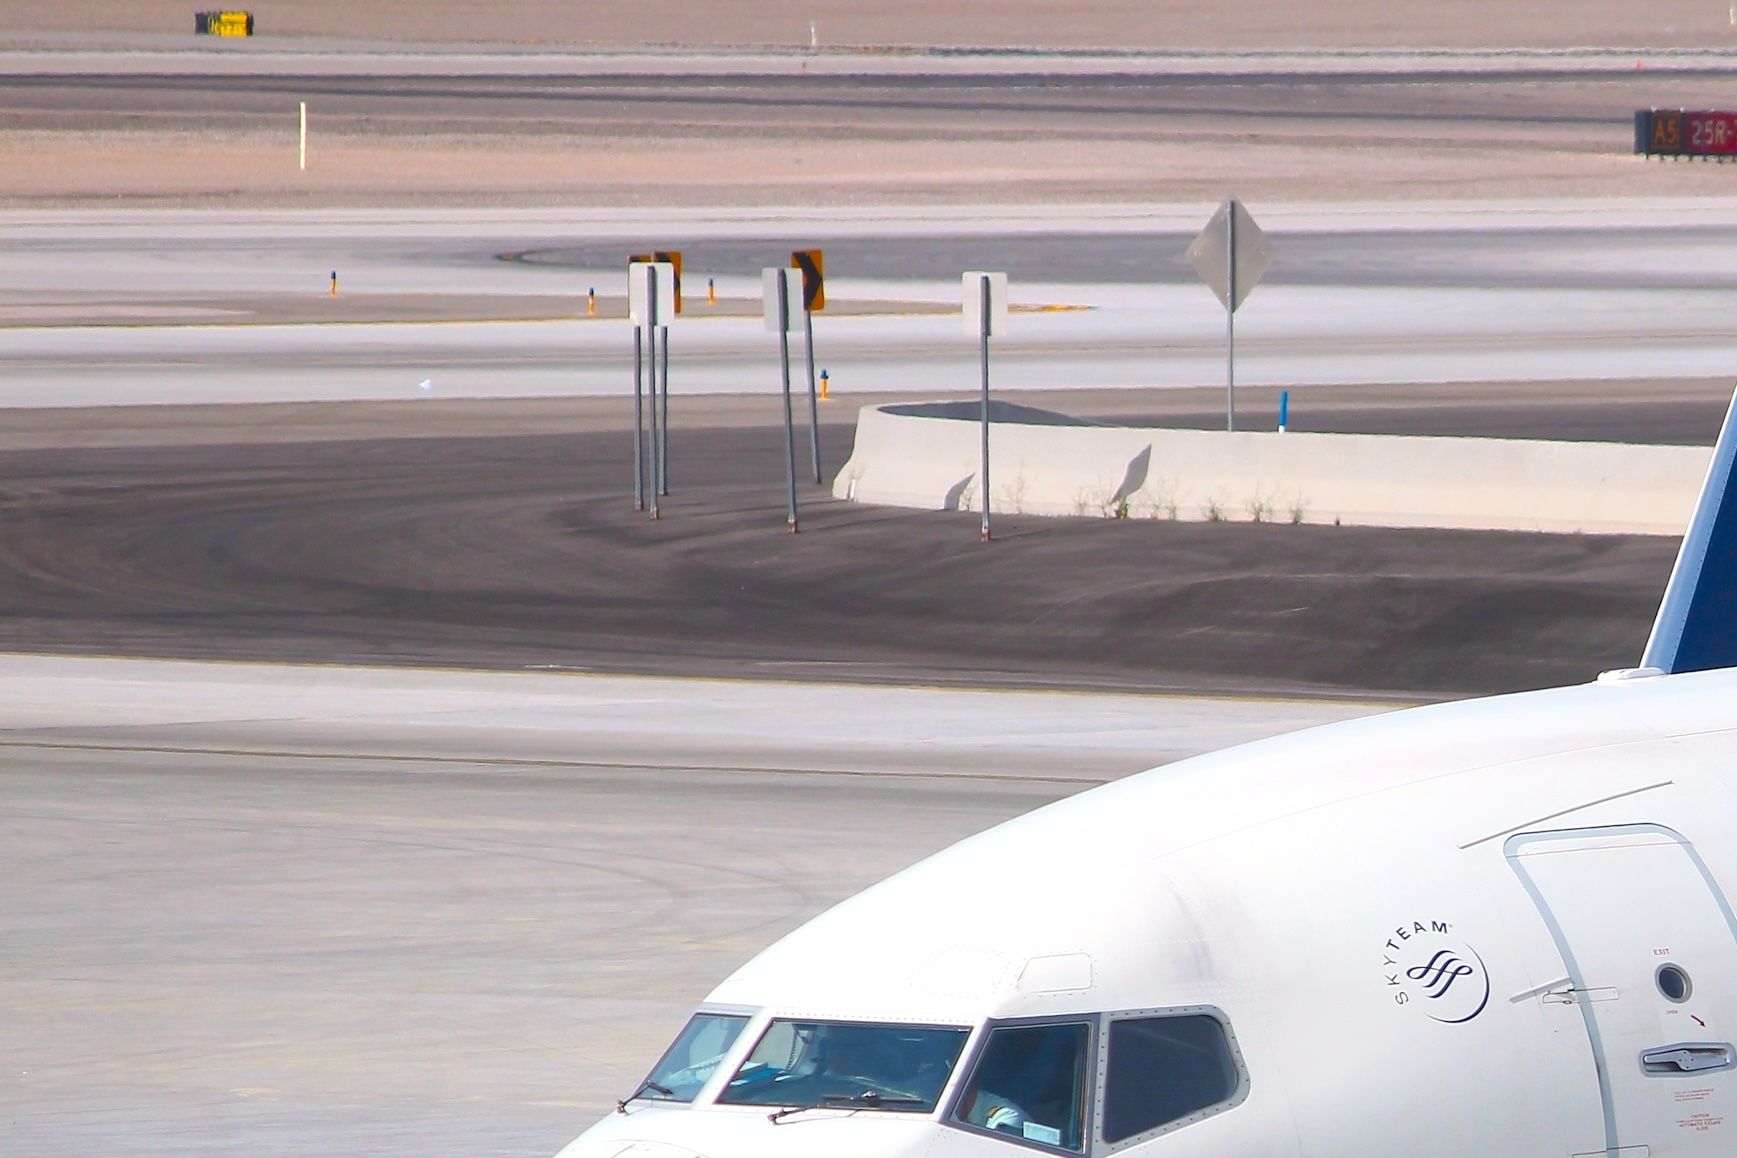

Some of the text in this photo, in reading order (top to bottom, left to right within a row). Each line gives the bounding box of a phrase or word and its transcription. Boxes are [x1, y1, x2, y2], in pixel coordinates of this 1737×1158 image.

[1655, 120, 1679, 144] A5
[1383, 920, 1449, 1005] SKYTEAM
[1653, 948, 1670, 956] EXIT
